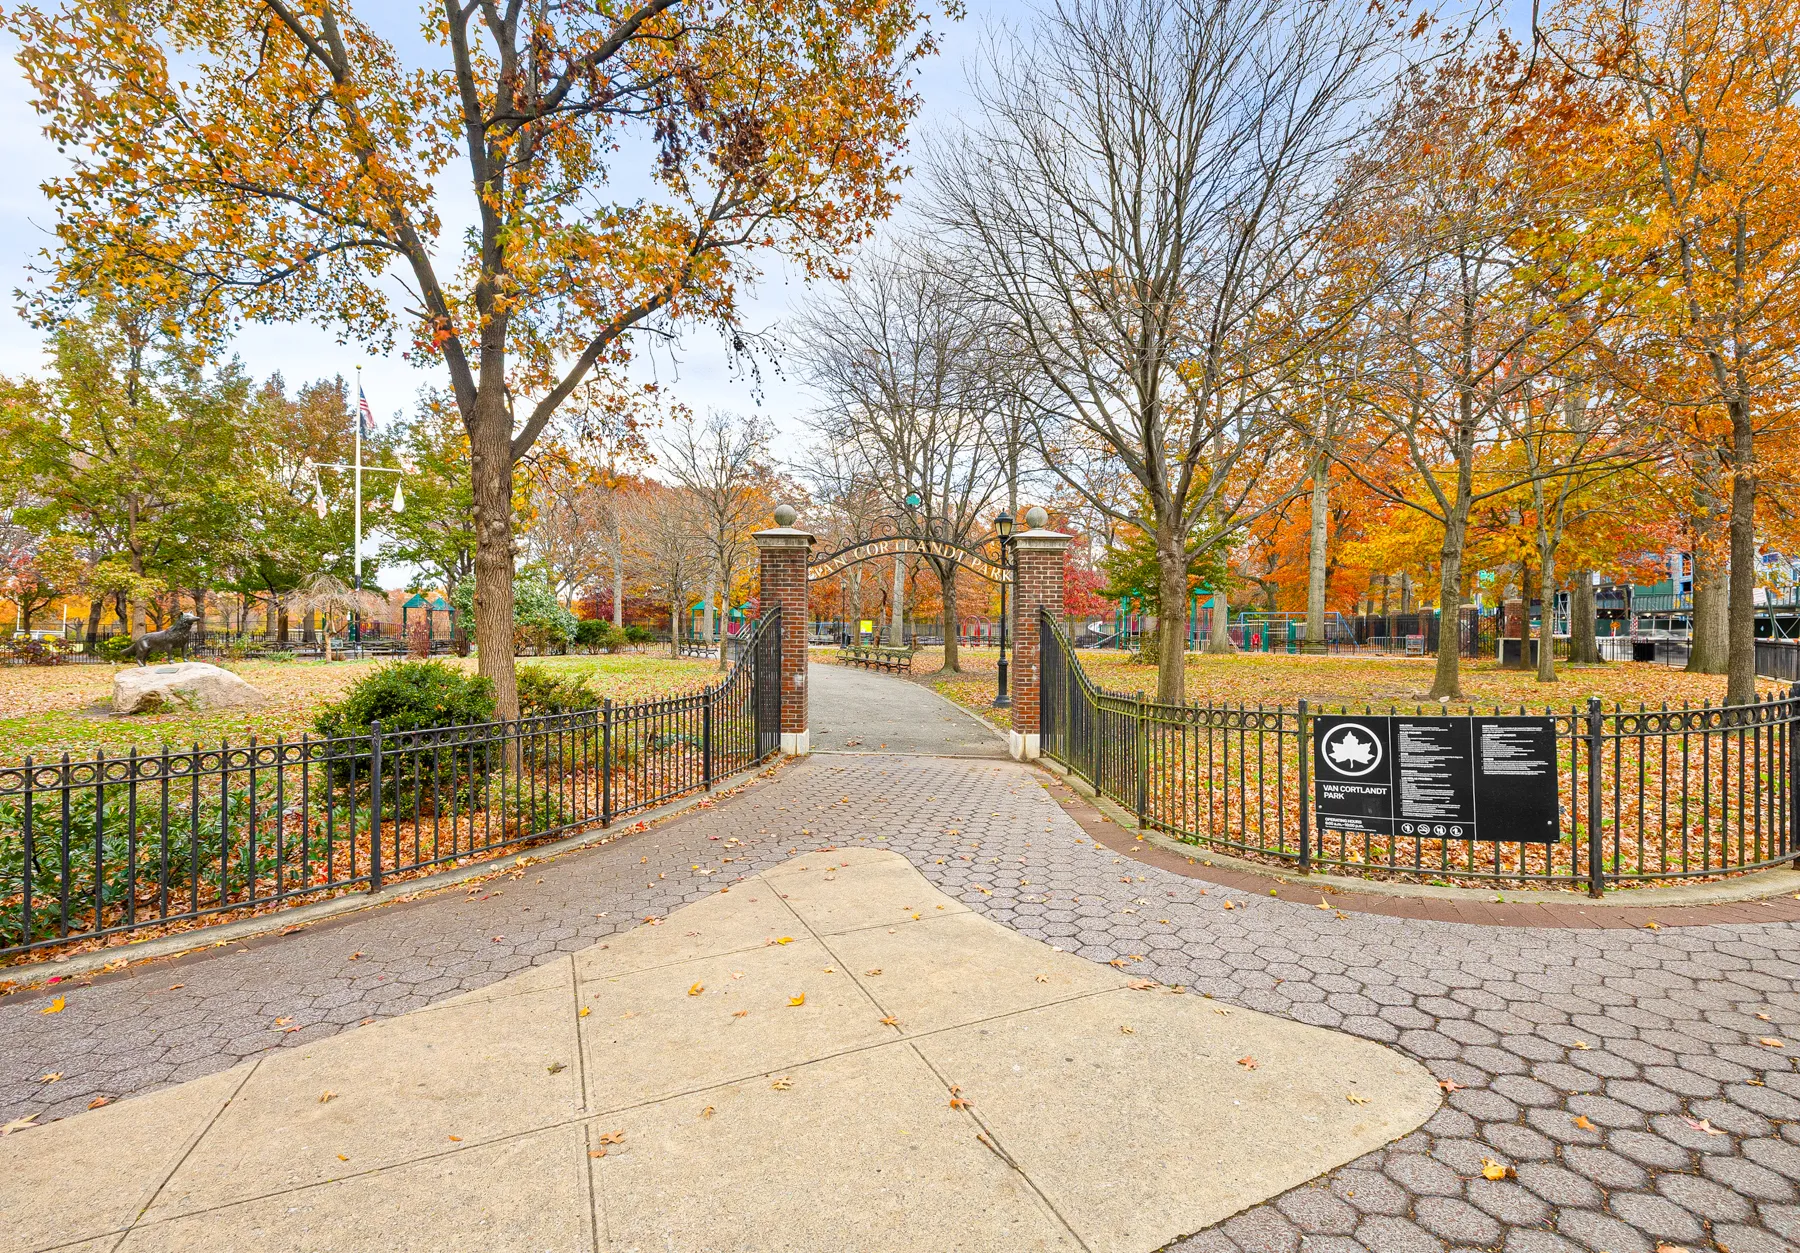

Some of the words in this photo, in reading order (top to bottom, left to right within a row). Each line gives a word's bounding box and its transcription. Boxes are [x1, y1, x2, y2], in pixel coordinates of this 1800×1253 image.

[813, 554, 848, 577] VAN
[854, 538, 968, 562] CORTLANDT
[971, 557, 1013, 582] PARK
[1323, 784, 1338, 792] VAN
[1339, 785, 1387, 795] CORTLANDT
[1324, 792, 1345, 800] PARK
